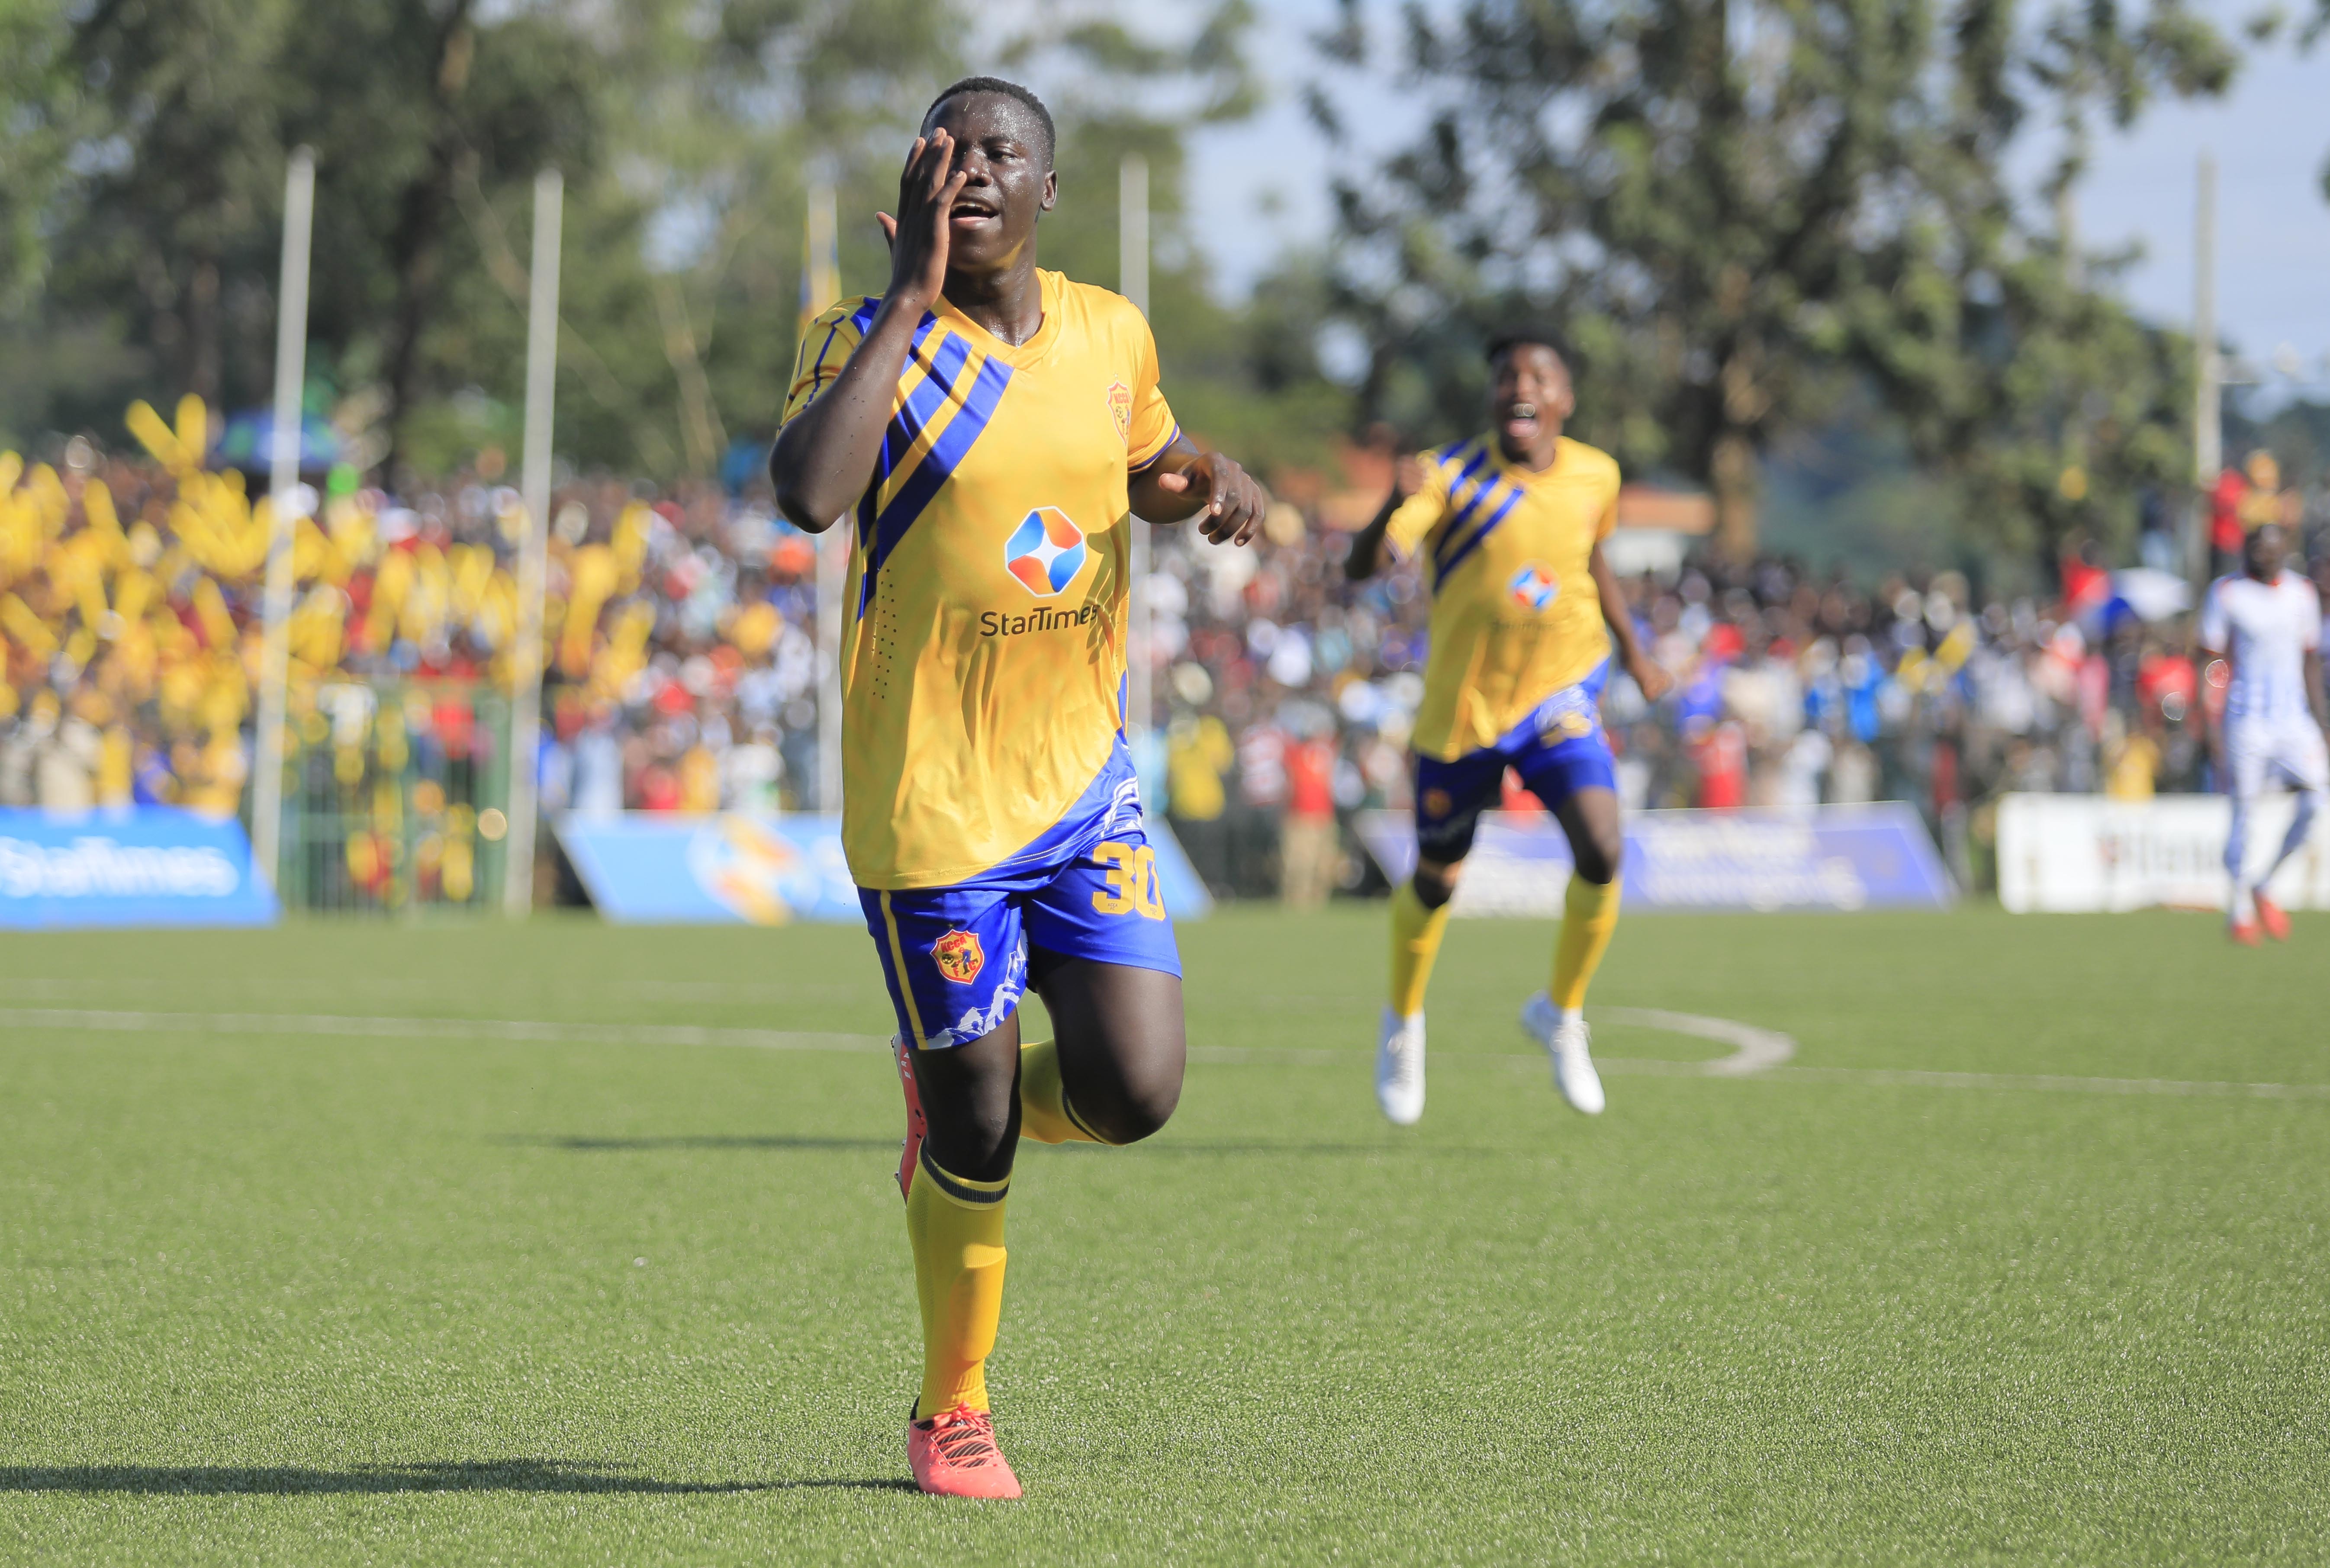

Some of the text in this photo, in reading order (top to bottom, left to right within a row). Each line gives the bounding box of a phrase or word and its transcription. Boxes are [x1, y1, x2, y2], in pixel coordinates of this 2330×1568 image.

[1114, 392, 1130, 404] KCCA
[980, 605, 1100, 636] StarTimes
[1092, 841, 1166, 921] 30
[940, 936, 967, 952] KCCA
